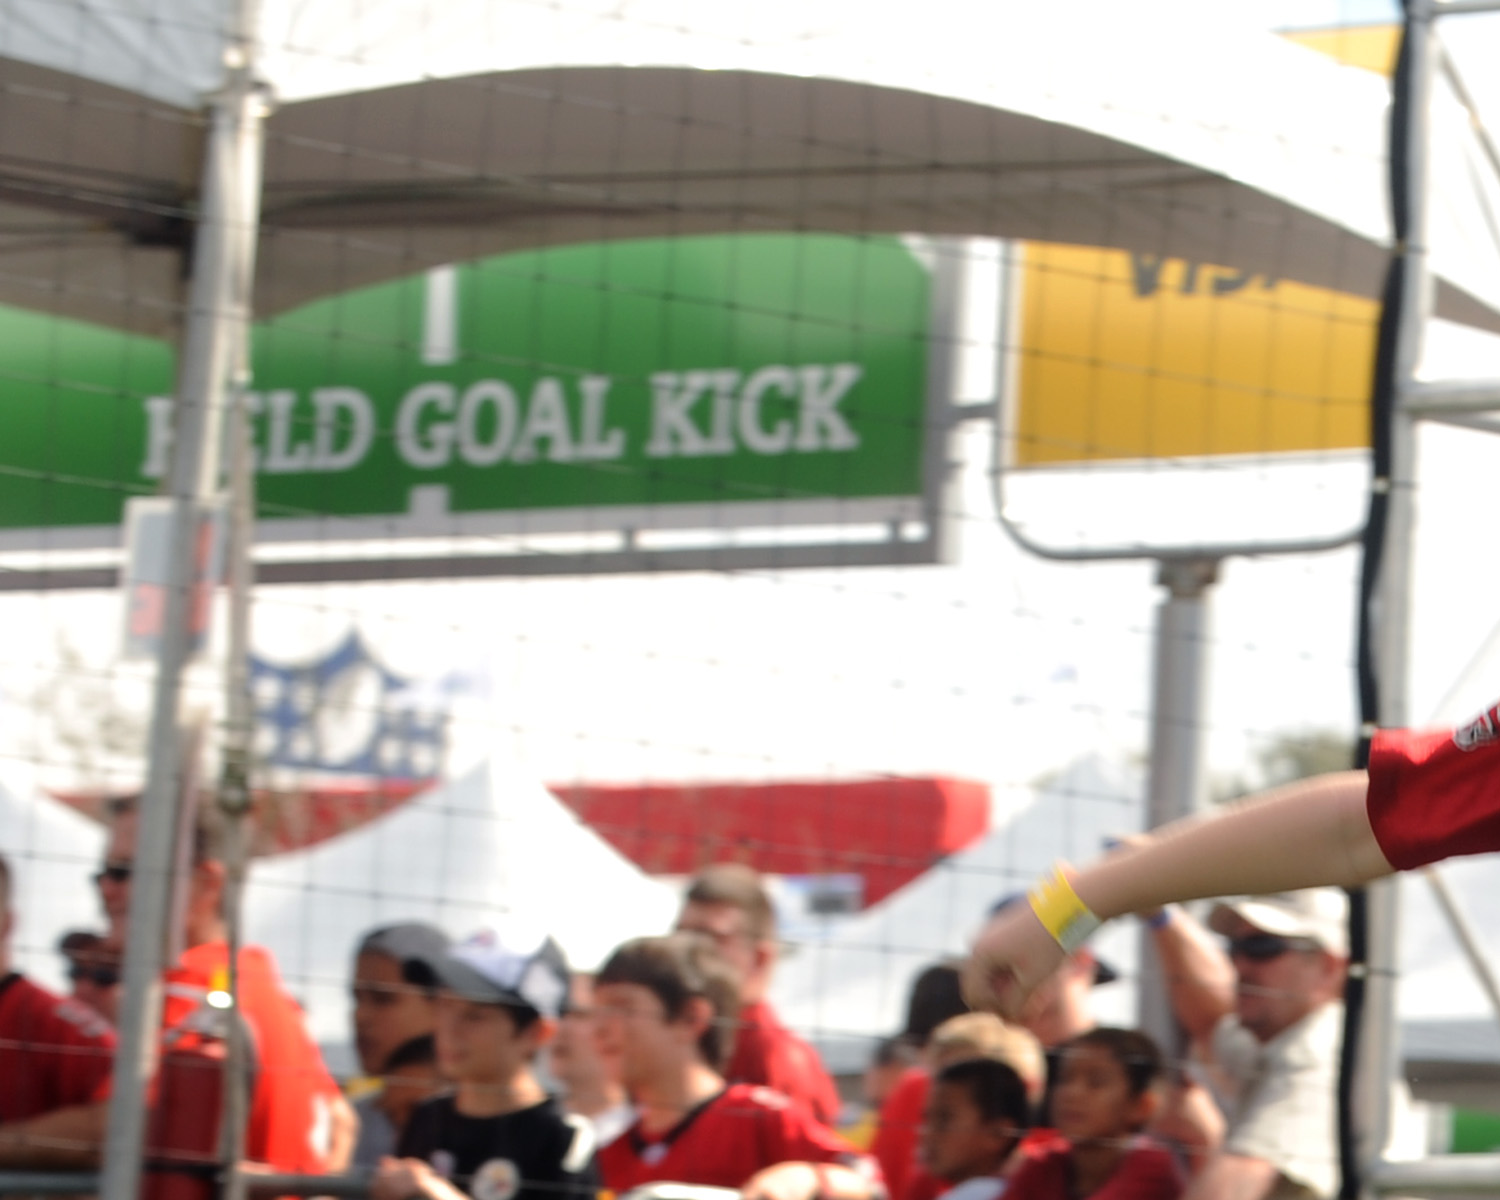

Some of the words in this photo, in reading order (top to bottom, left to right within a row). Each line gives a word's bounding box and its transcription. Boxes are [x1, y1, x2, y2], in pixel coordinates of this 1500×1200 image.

[141, 385, 376, 478] FELD
[394, 377, 626, 469] GOAL
[643, 363, 861, 457] KICK
